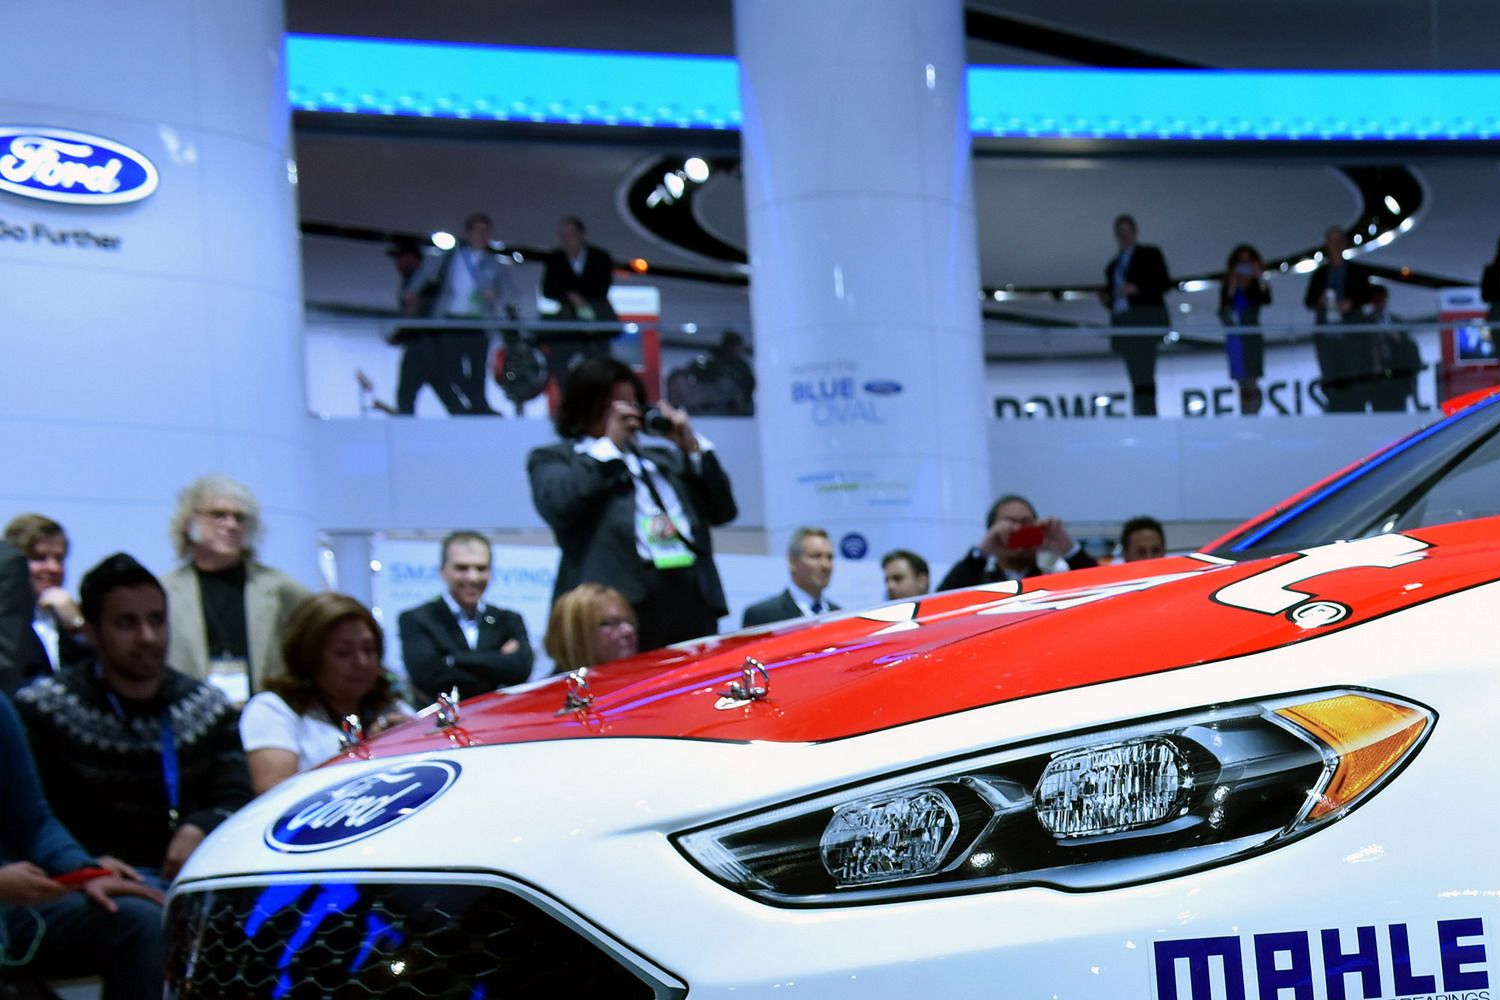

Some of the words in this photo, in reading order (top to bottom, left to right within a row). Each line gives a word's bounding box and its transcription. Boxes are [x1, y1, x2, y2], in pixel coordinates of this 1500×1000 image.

[0, 135, 122, 193] Ford
[31, 222, 122, 249] Further
[285, 771, 423, 830] Ford
